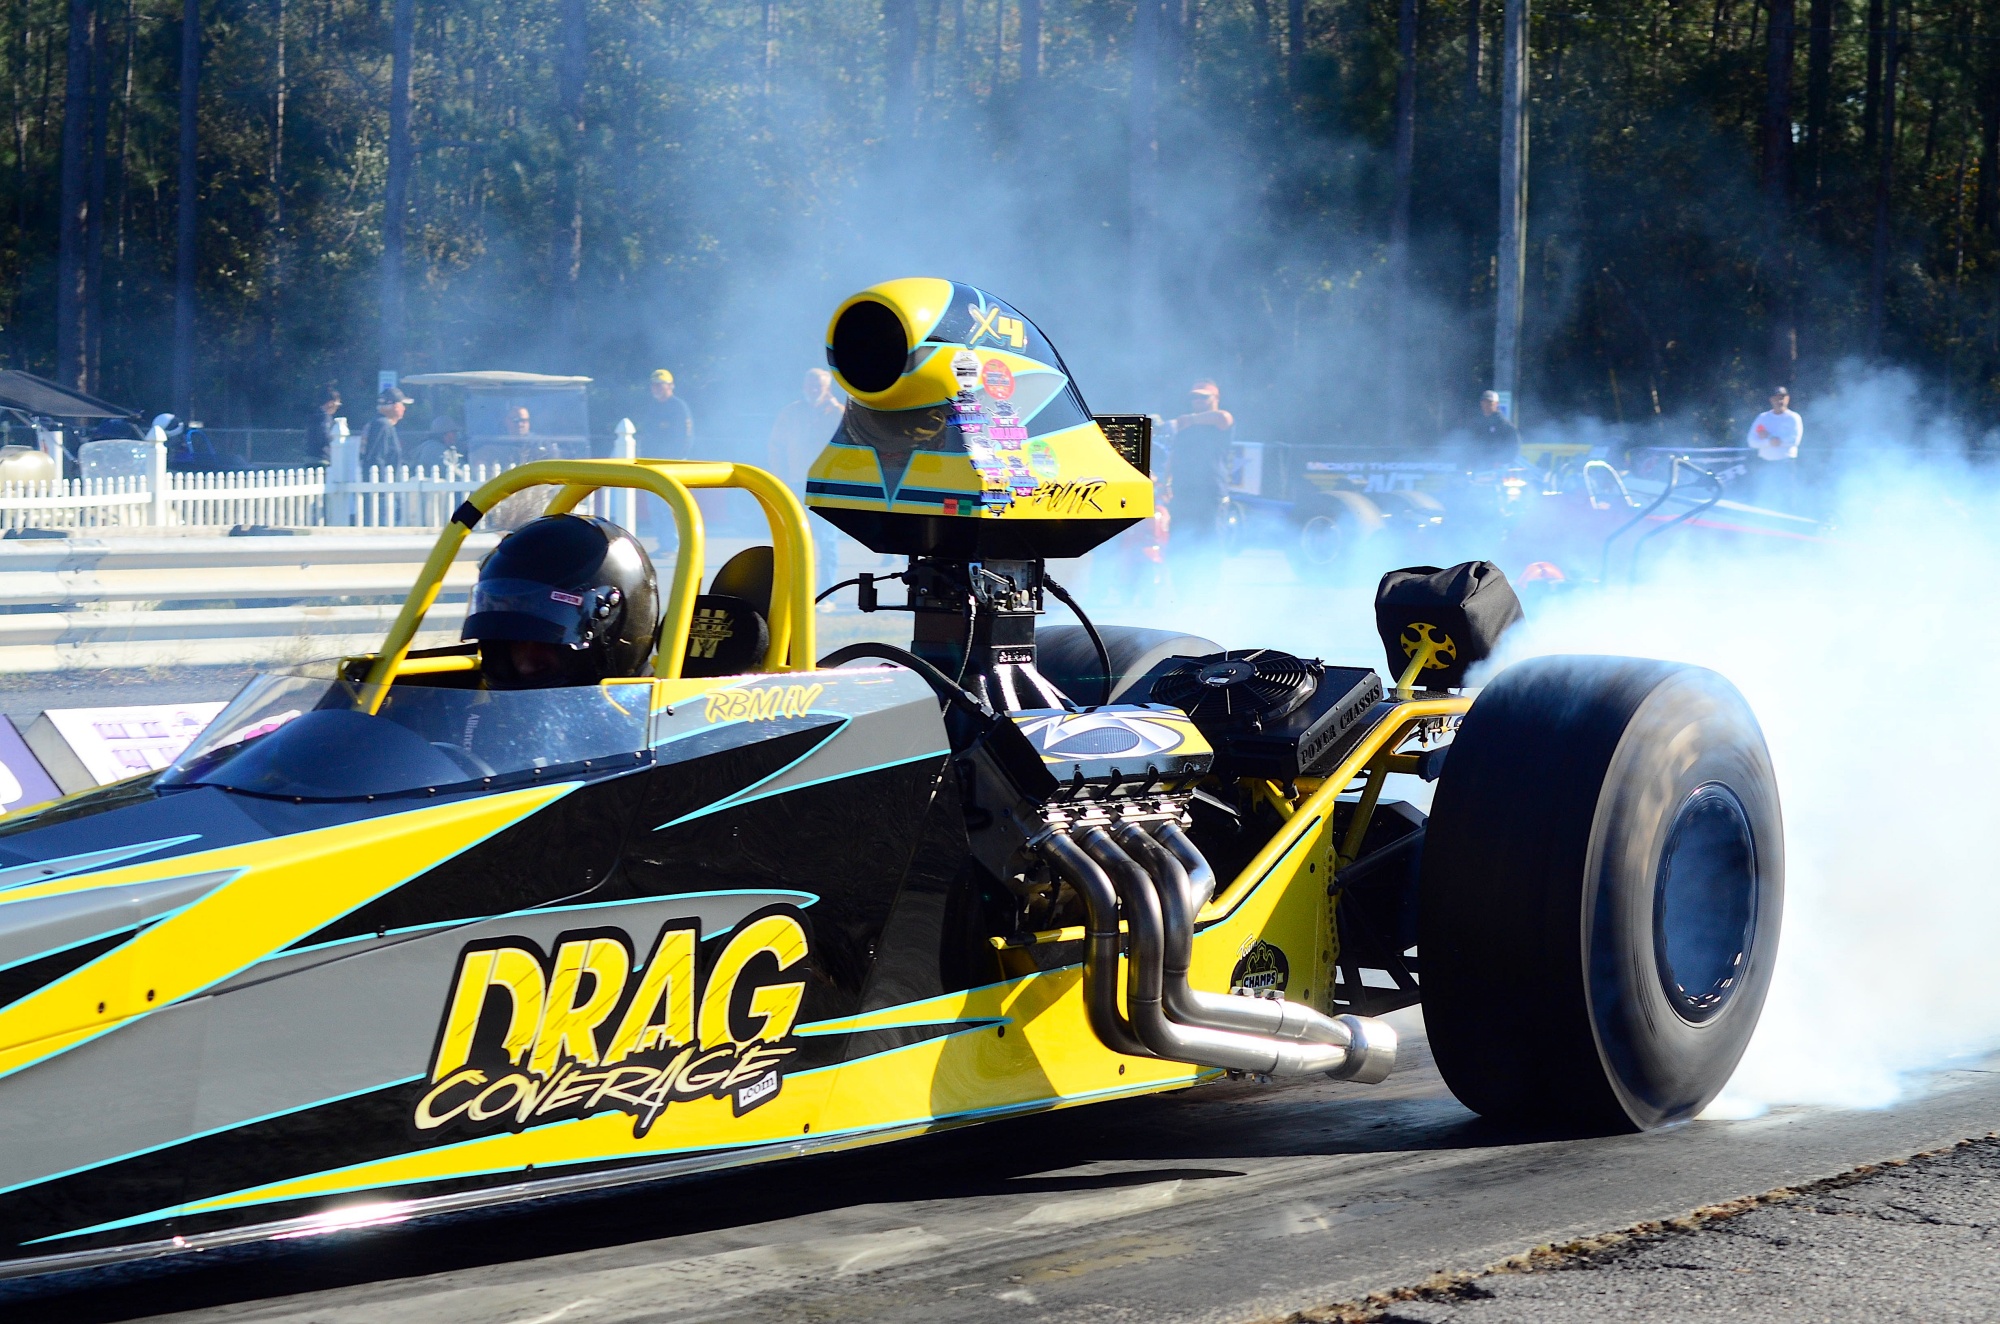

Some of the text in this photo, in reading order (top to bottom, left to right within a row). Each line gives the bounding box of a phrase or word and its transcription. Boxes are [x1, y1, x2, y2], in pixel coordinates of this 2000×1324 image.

[968, 305, 1024, 349] X4
[1301, 684, 1380, 766] POWER CHASSIS
[431, 914, 809, 1084] DRAG
[1243, 971, 1276, 988] CHAMPS
[414, 1046, 797, 1130] COVERAGE
[743, 1077, 774, 1101] .com
